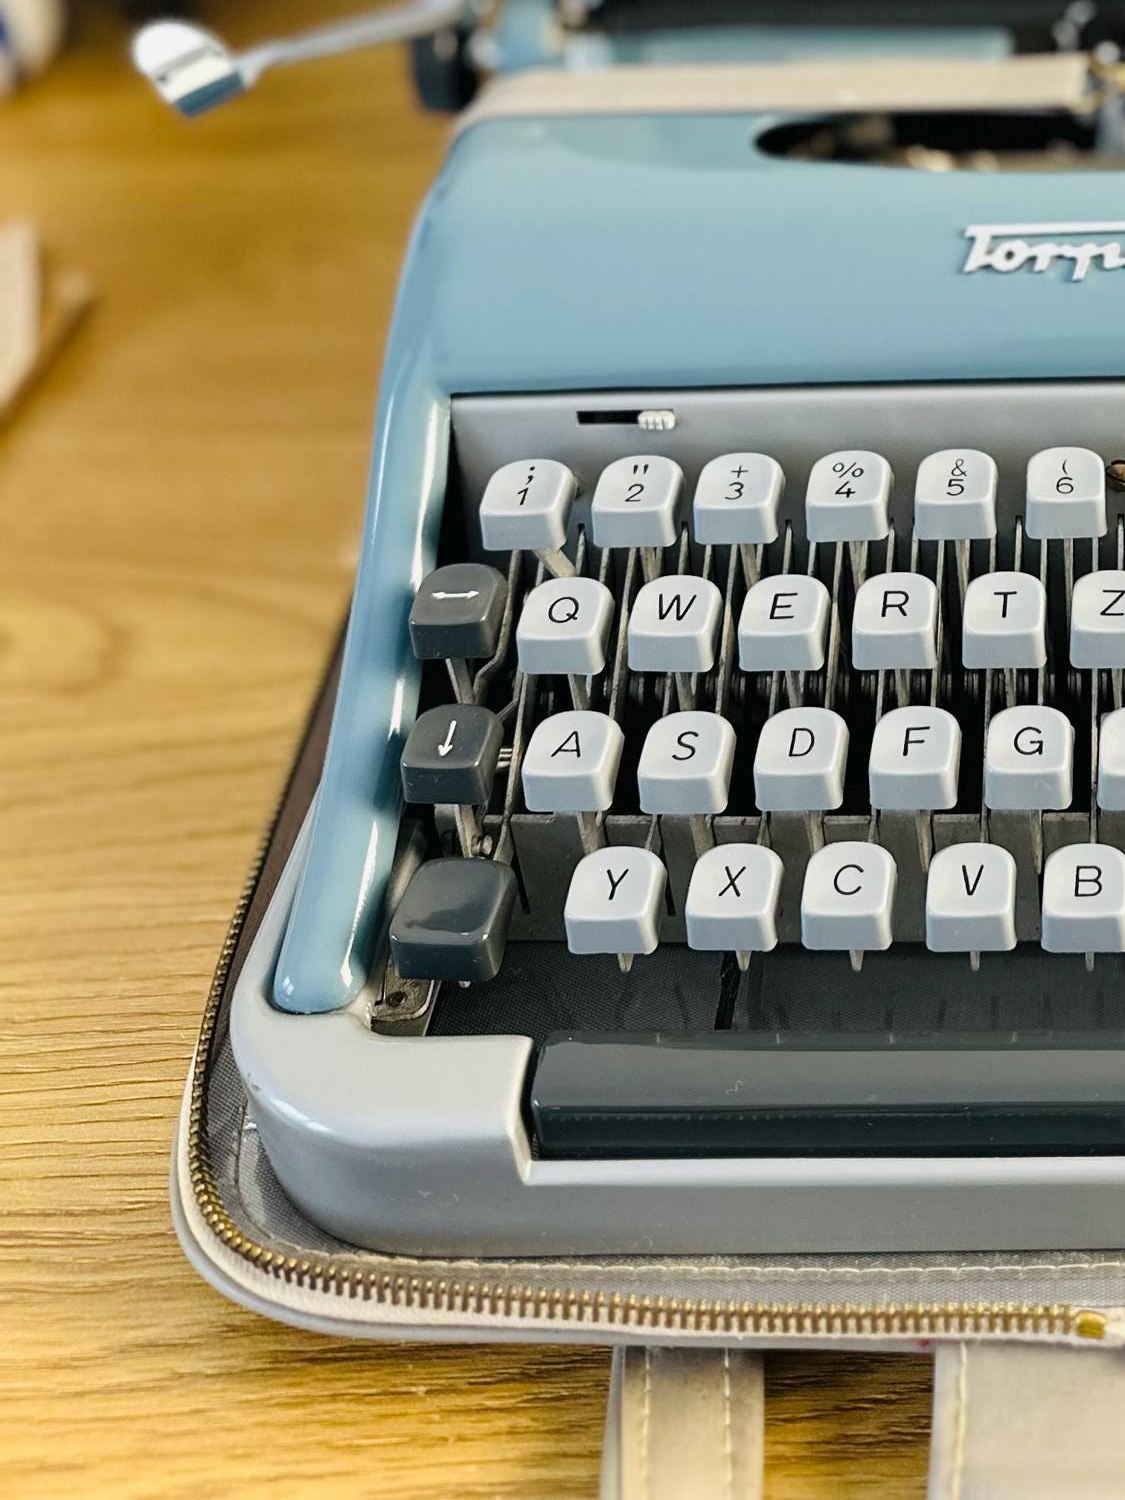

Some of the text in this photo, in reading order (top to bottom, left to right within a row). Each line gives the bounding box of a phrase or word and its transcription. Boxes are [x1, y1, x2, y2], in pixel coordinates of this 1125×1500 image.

[731, 465, 749, 479] +
[832, 461, 865, 479] %
[950, 458, 968, 477] &
[517, 487, 529, 506] 1
[624, 483, 645, 503] 2
[724, 481, 745, 501] 3
[834, 480, 856, 499] 4
[946, 478, 965, 497] 5
[1055, 476, 1074, 495] 6
[547, 596, 580, 624] Q
[658, 593, 697, 622] W
[769, 592, 799, 620] E
[880, 590, 910, 618] R
[993, 590, 1018, 619] T
[1099, 589, 1125, 617] Z
[550, 730, 581, 759] A
[671, 730, 699, 761] S
[788, 727, 815, 758] D
[902, 725, 931, 757] F
[1013, 726, 1044, 756] G
[606, 868, 629, 901] Y
[718, 865, 747, 898] X
[833, 863, 865, 896] C
[961, 864, 985, 896] V
[1074, 865, 1103, 898] B
